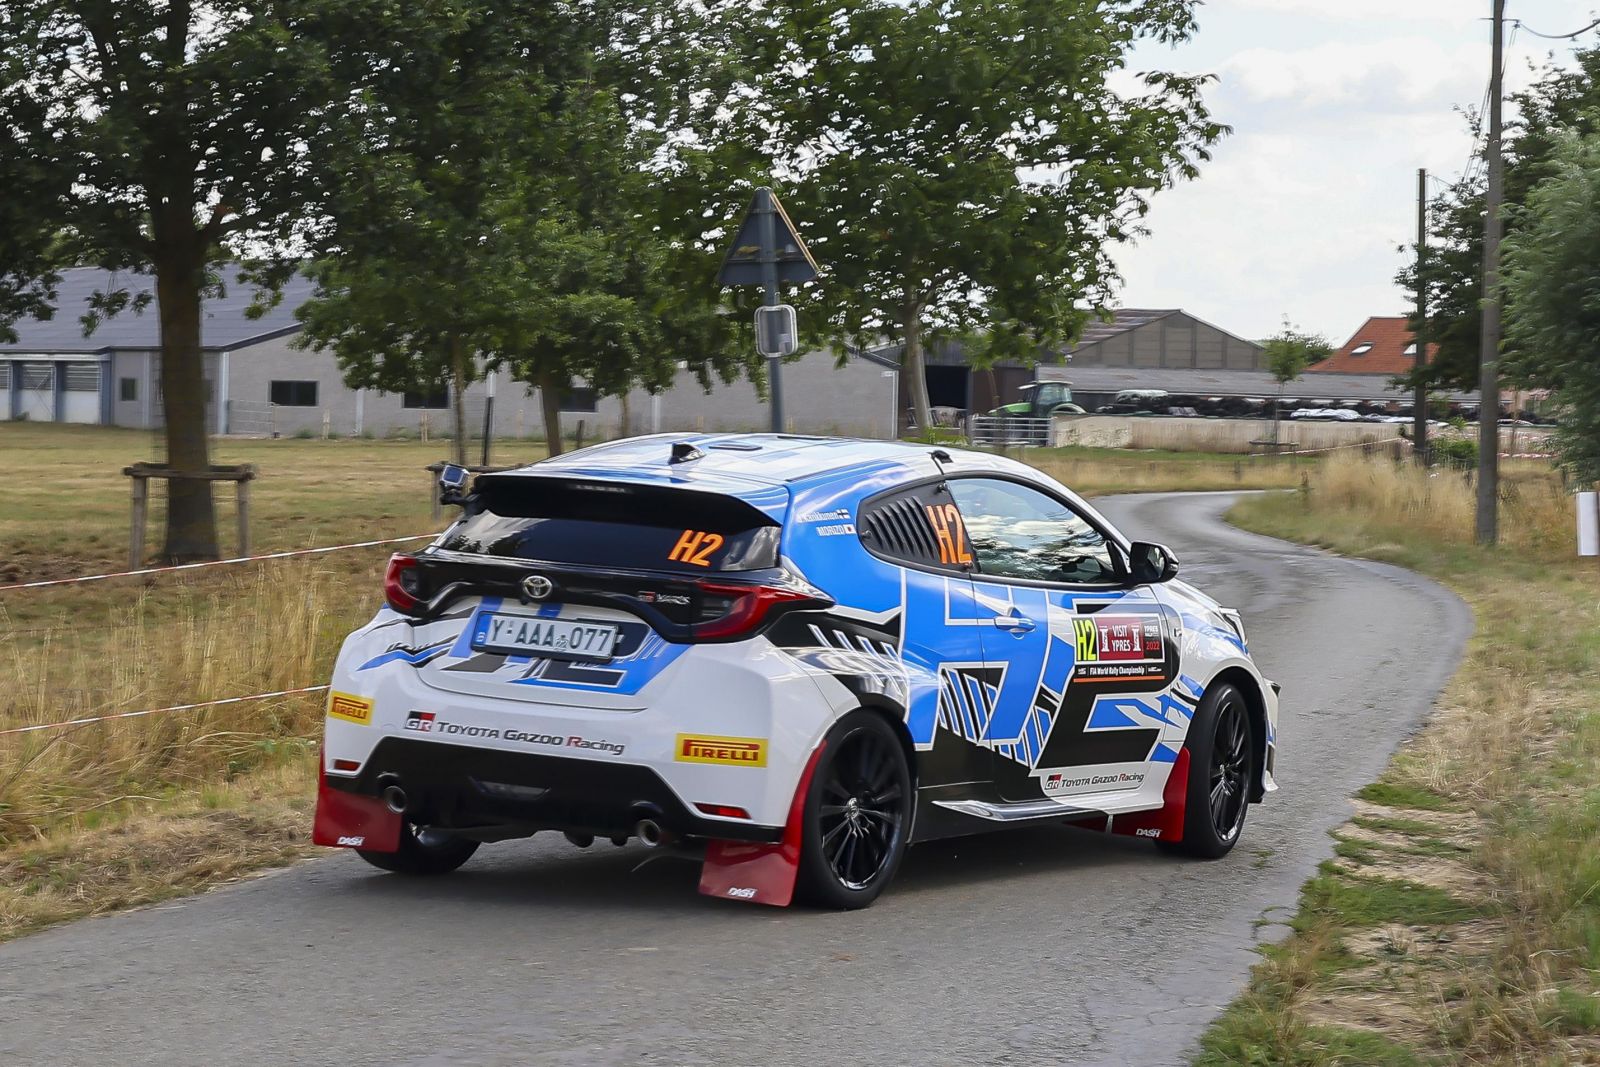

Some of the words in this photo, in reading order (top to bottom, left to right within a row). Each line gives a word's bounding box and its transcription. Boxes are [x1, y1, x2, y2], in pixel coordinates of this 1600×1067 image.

[926, 503, 972, 564] H2
[667, 529, 724, 567] H2
[1073, 620, 1097, 660] H2
[1112, 625, 1128, 637] VISIT
[1112, 639, 1131, 652] YPRES
[1146, 641, 1160, 650] 2022
[332, 696, 369, 719] PIRELLI
[404, 716, 433, 732] GR
[437, 721, 500, 739] TOYOTA
[503, 729, 564, 746] GAZOO
[566, 736, 625, 755] Racing
[683, 739, 760, 761] PIRELLI
[1062, 778, 1090, 788] TOYOTA
[1091, 775, 1117, 785] GAZOO
[1118, 773, 1144, 783] Racing
[1135, 828, 1162, 838] DASH
